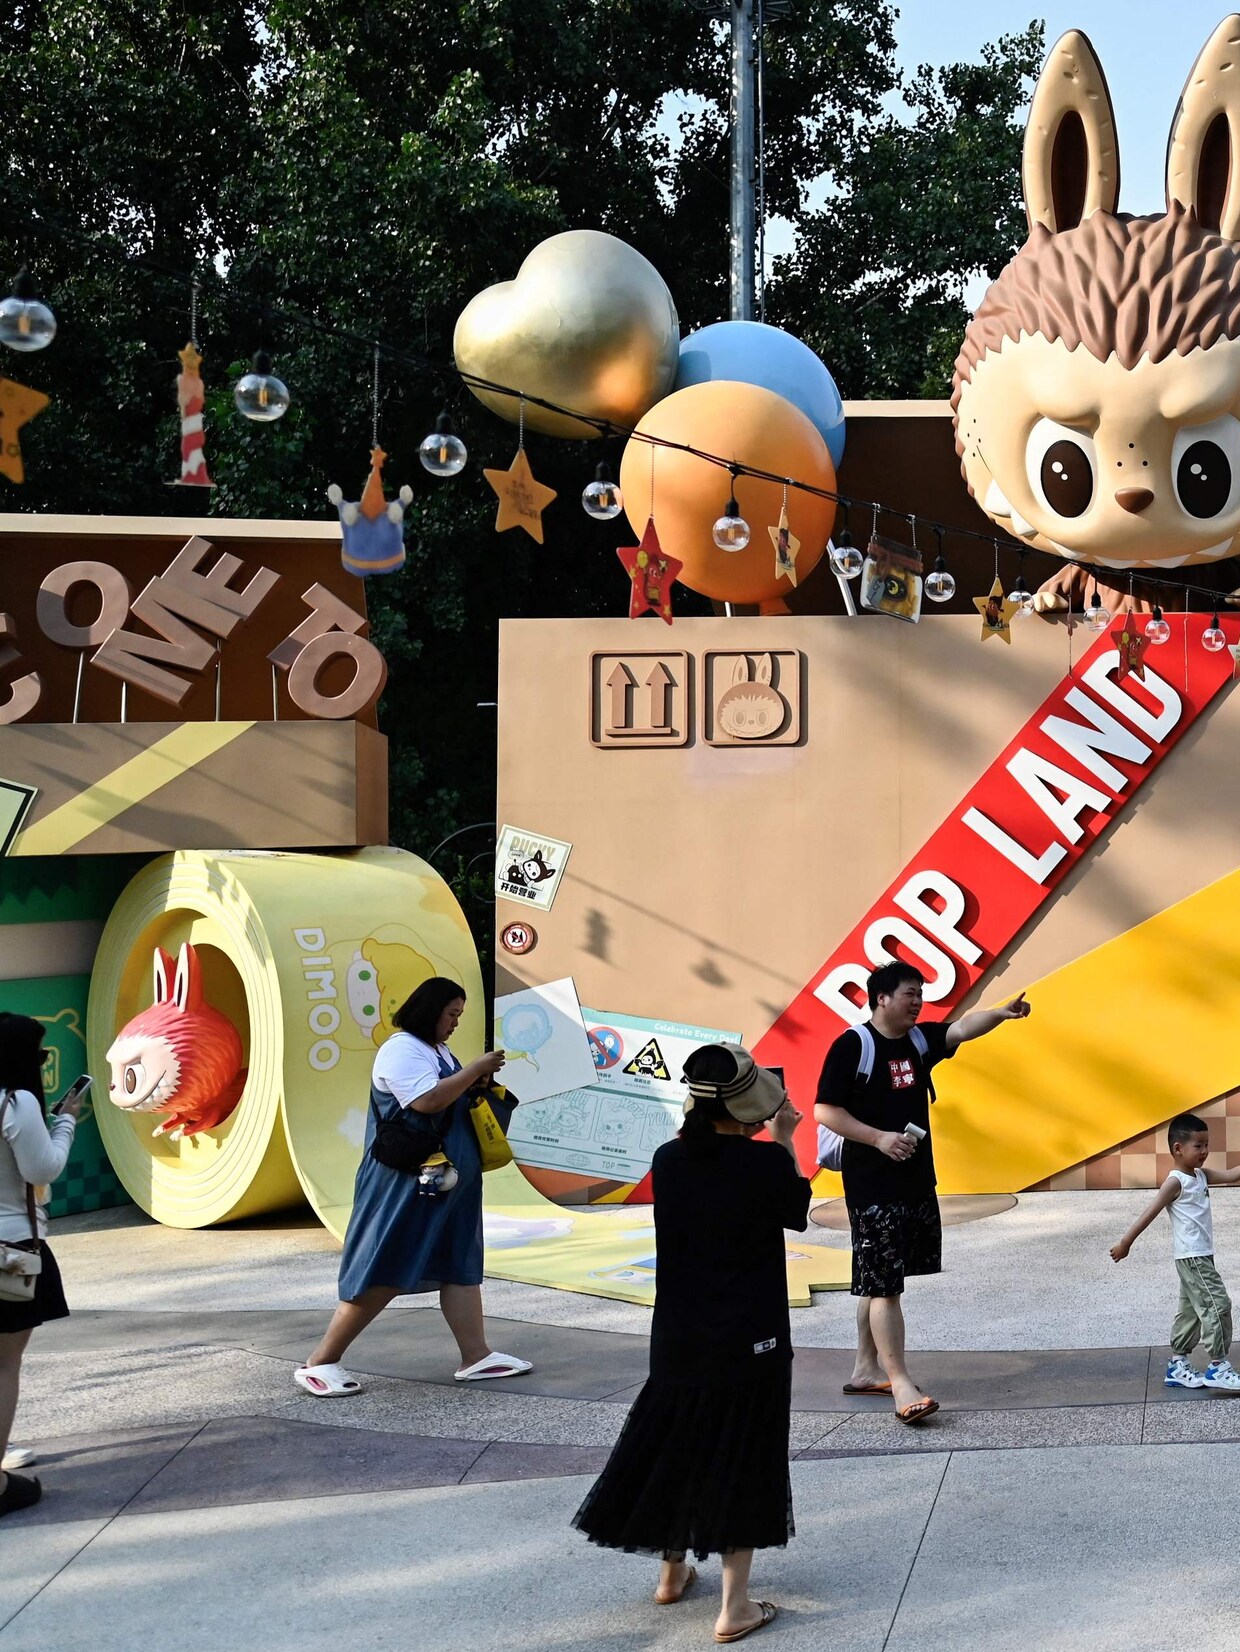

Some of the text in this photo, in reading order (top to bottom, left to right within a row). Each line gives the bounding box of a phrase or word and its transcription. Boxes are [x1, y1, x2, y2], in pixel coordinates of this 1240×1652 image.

[266, 582, 388, 720] TO
[960, 648, 1184, 886] LAND
[500, 882, 537, 900] 开始营业
[292, 928, 341, 1072] DIMOO
[654, 1022, 693, 1036] Celebrate
[694, 1030, 718, 1041] Every
[602, 1160, 616, 1170] TOP
